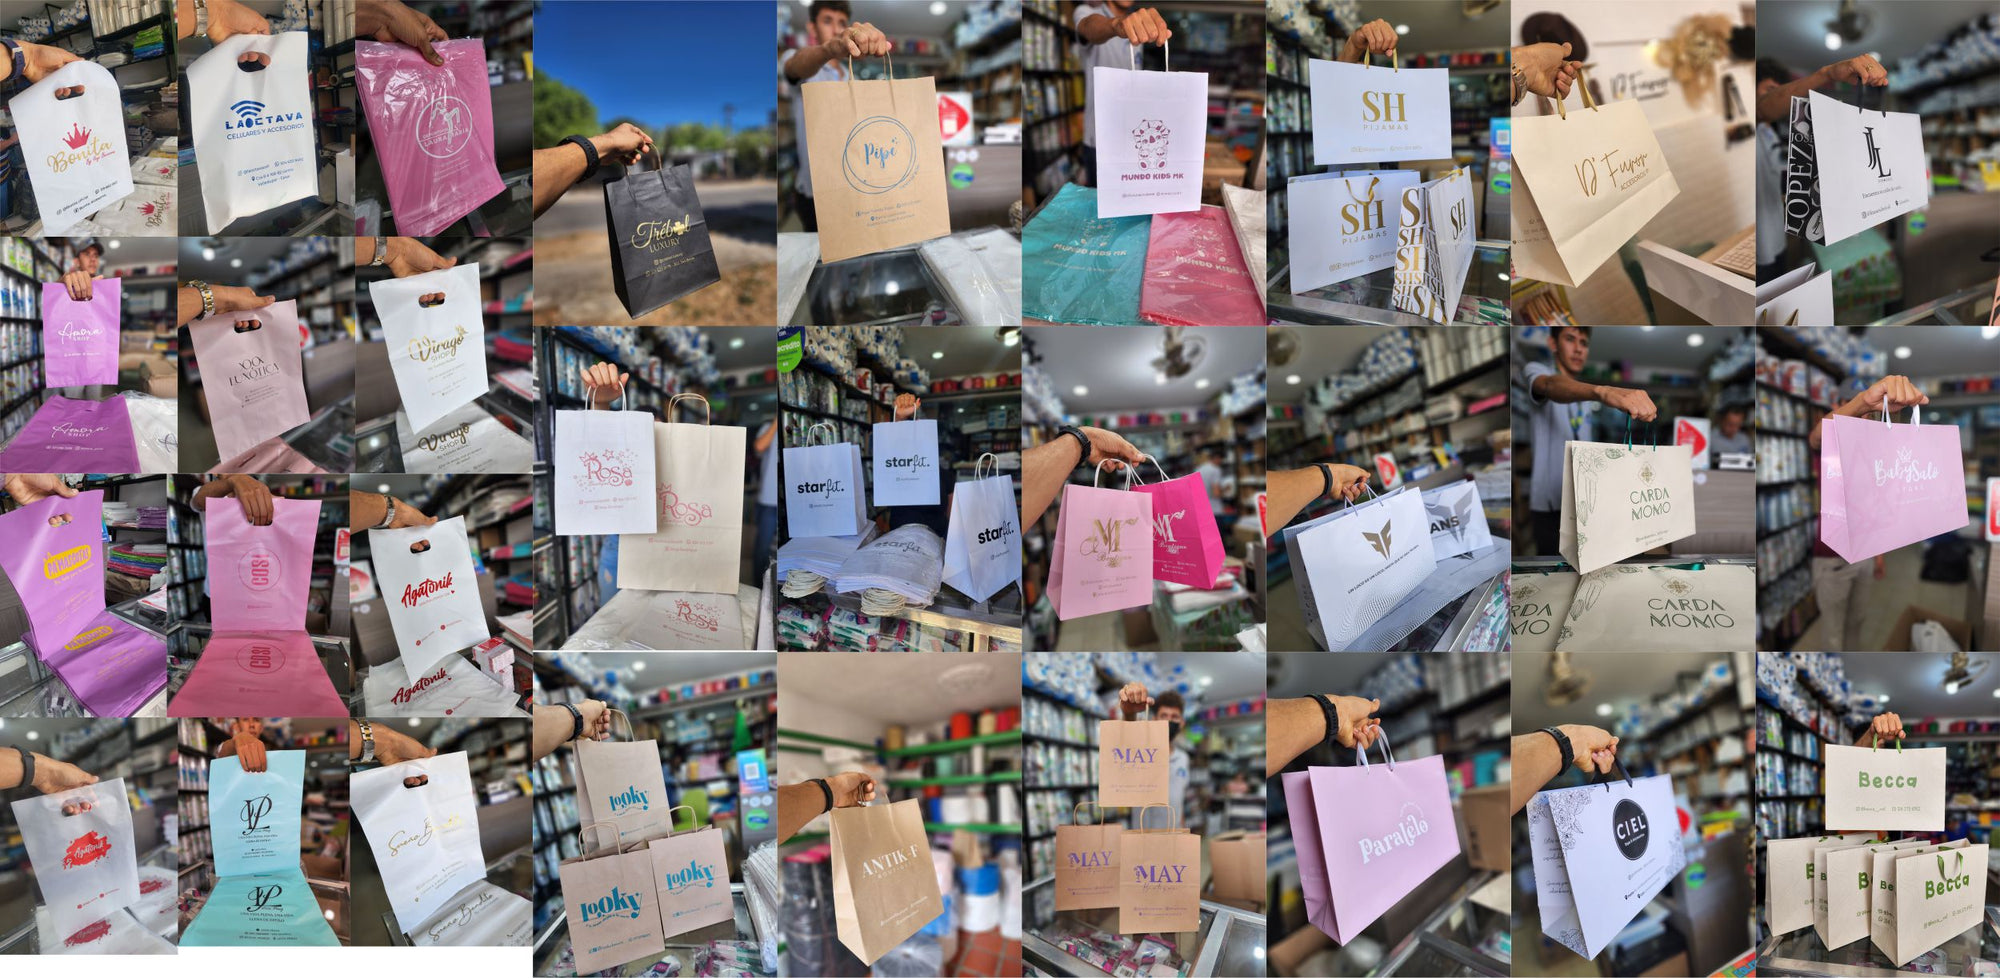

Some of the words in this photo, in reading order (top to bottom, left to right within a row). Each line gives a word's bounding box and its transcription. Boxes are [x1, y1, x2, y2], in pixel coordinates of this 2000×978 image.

[1362, 91, 1408, 123] SH
[226, 130, 261, 140] CELULARES
[267, 123, 305, 134] ACCESORIOS
[1363, 123, 1409, 131] PIJAMAS
[46, 136, 113, 173] Bonita
[1121, 173, 1151, 181] MUNDO
[1153, 172, 1171, 180] KIDS
[1173, 172, 1184, 180] MK
[1341, 200, 1386, 237] SH
[1450, 197, 1467, 240] SH
[649, 236, 681, 254] LUXURY
[1342, 230, 1387, 245] PIJAMAS
[1630, 487, 1670, 504] CARDA
[1631, 502, 1671, 521] MOMO
[401, 571, 453, 608] Agatonik
[1648, 599, 1726, 611] CARDA
[1650, 613, 1735, 629] MOMO
[391, 667, 448, 705] Agatonik
[1113, 748, 1158, 764] MAY
[1859, 771, 1917, 788] Becca
[1617, 815, 1646, 839] CIEL
[1068, 851, 1112, 867] MAY
[1134, 865, 1187, 883] MAY
[1925, 874, 1970, 899] Becca
